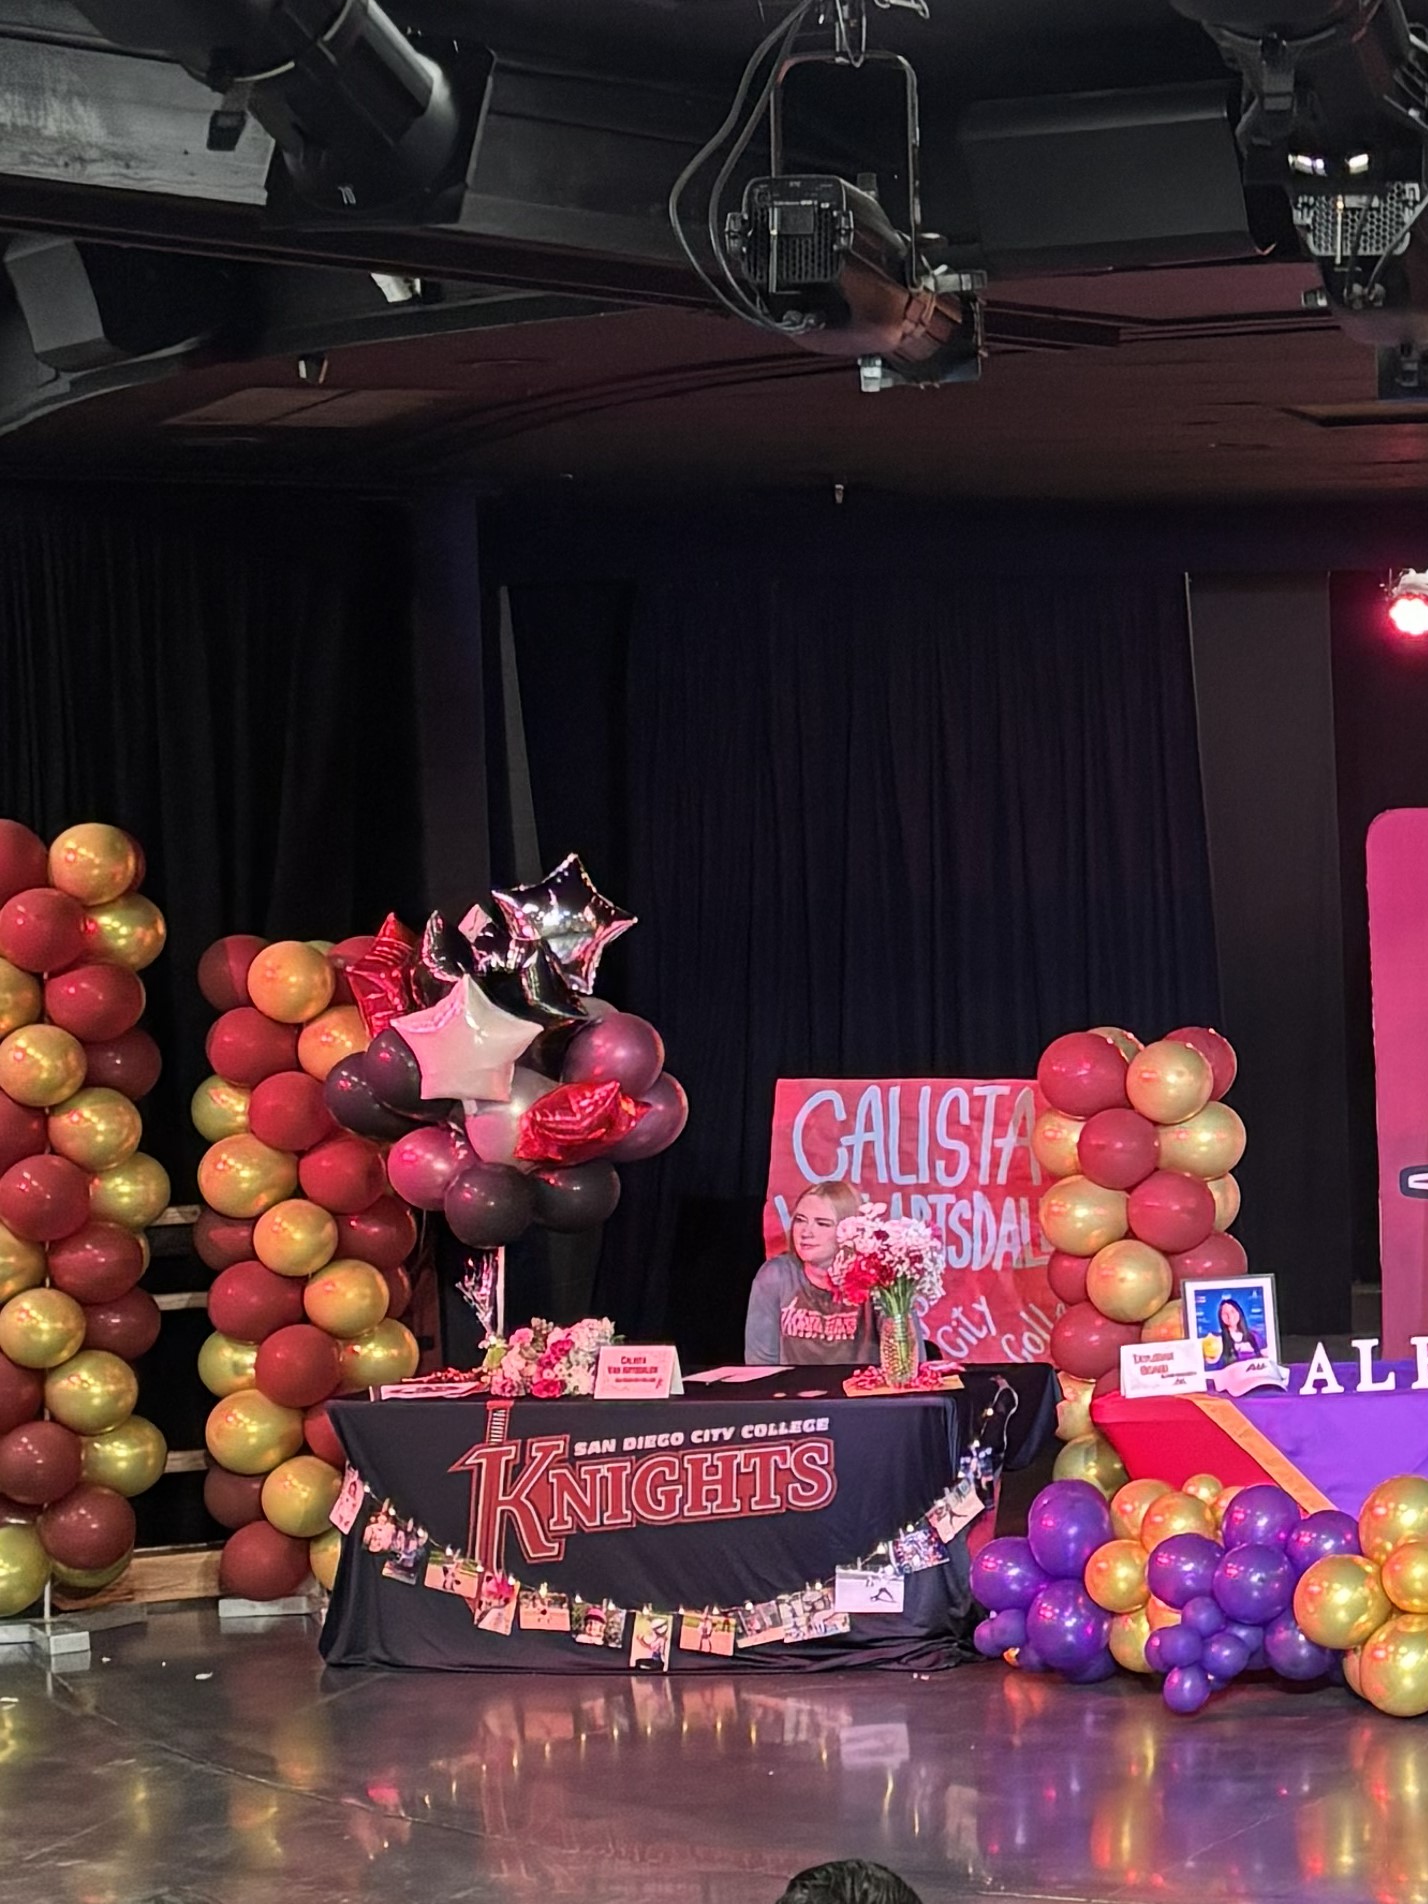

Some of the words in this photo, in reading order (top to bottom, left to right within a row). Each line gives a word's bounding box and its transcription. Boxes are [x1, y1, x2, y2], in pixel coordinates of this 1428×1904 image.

[793, 1085, 1041, 1186] CALISTA
[1001, 1302, 1066, 1363] Coll
[574, 1438, 617, 1457] SAN
[622, 1432, 684, 1451] DIEGO
[690, 1426, 736, 1444] CITY
[741, 1417, 830, 1439] COLLEGE
[449, 1434, 836, 1564] KNIGHTS
